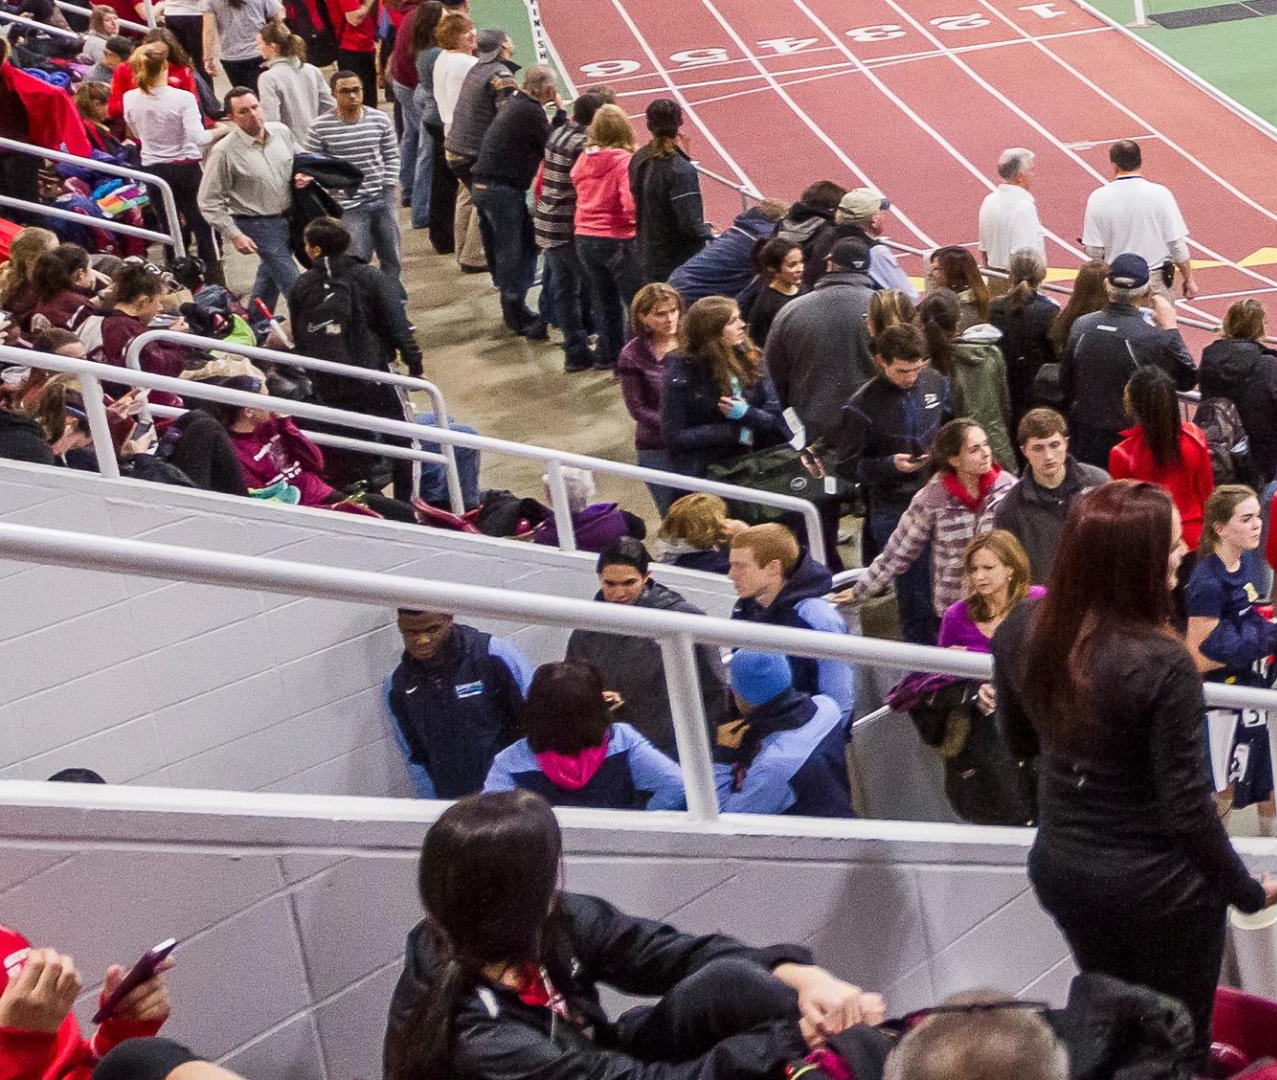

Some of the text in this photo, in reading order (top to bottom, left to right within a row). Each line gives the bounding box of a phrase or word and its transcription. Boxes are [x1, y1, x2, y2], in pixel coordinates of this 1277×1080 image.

[1017, 2, 1068, 19] 1
[929, 12, 991, 31] 2
[845, 24, 907, 42] 3
[756, 36, 820, 55] 4
[669, 48, 730, 68] 5
[579, 59, 641, 78] 6
